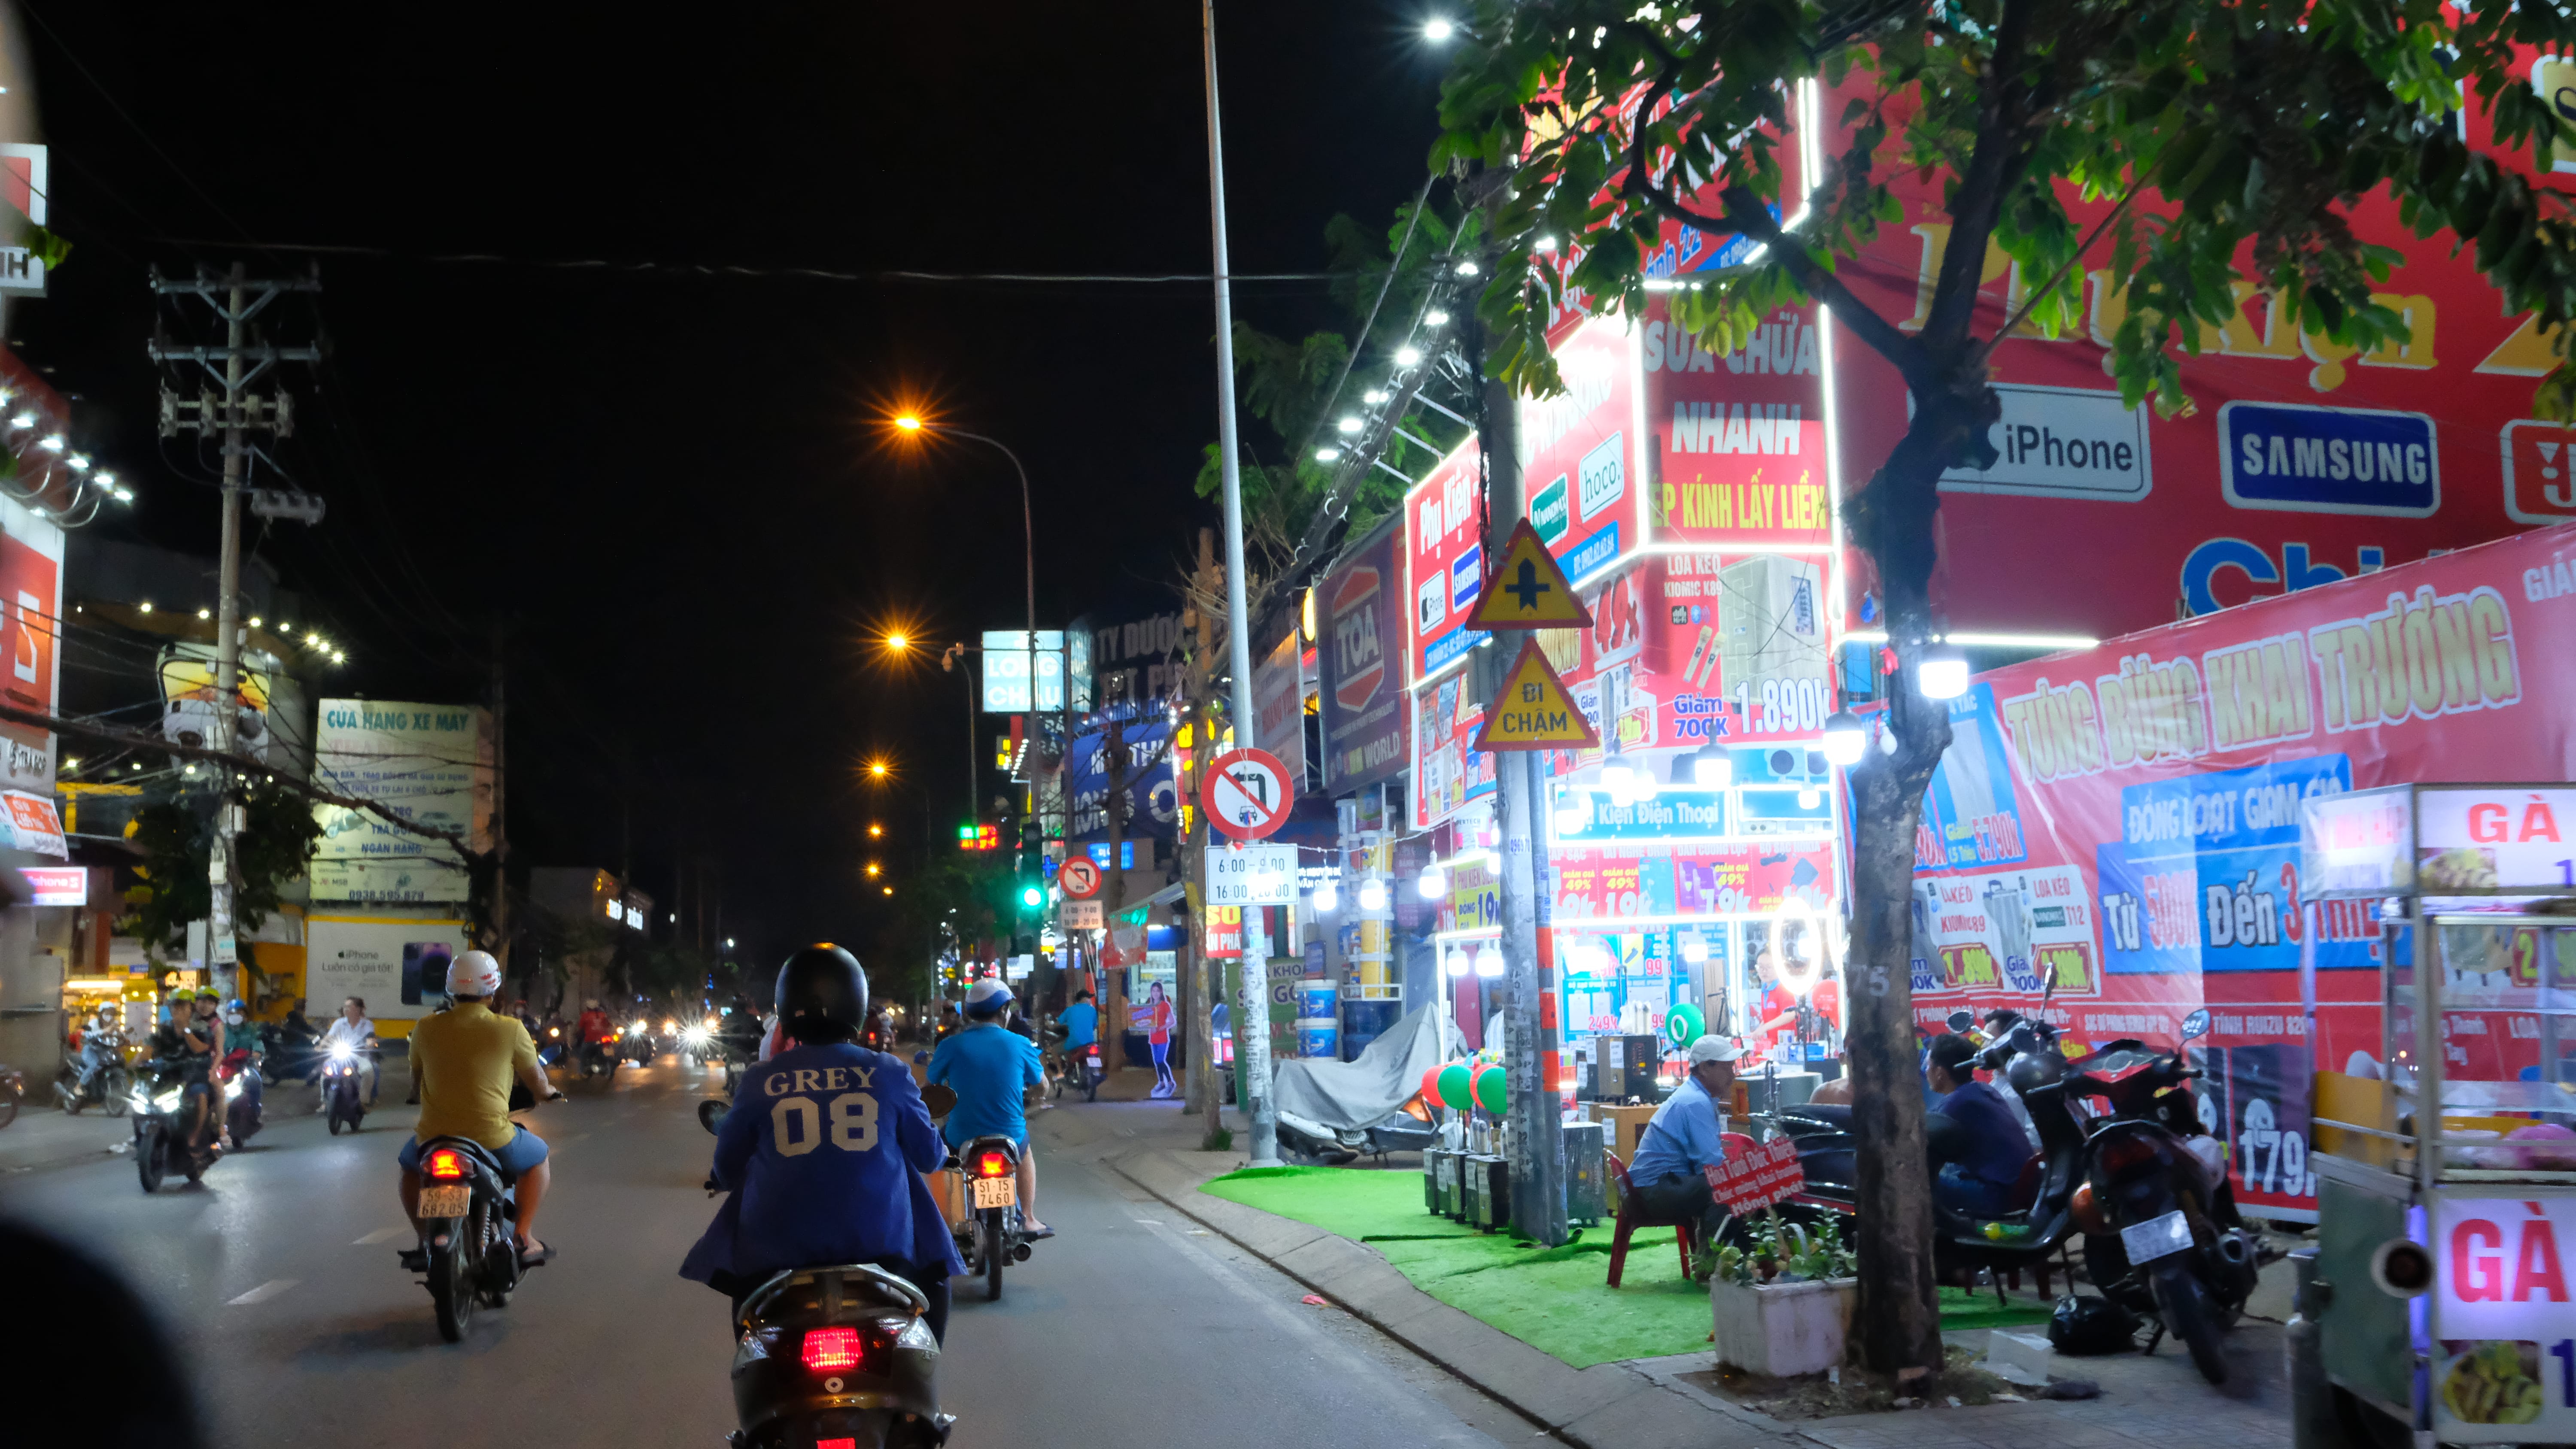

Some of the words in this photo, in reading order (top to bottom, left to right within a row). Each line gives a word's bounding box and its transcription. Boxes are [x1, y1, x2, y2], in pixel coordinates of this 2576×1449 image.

[1671, 400, 1801, 455] NHANH
[2005, 424, 2133, 471] iPhone
[2242, 433, 2427, 485] SAMSUNG
[1682, 473, 1732, 529] KÍNH
[1738, 467, 1774, 529] LẤY
[1780, 469, 1827, 530] LIỀN
[1420, 497, 1442, 559] Phụ
[1454, 558, 1479, 596] SAMSUNG
[1667, 555, 1693, 576] LOA
[1337, 604, 1379, 674] TOA
[1674, 694, 1722, 715] Giảm
[2203, 632, 2314, 752] KHAI
[1503, 707, 1567, 737] CHẬM
[1363, 731, 1402, 770] WORLD
[1637, 800, 1674, 831] Điện
[1676, 801, 1719, 829] Thoại
[2128, 788, 2180, 844] ĐỒNG
[2467, 795, 2563, 843] GÀ
[1219, 858, 1245, 873] 6:00
[1260, 858, 1285, 872] 900
[1565, 879, 1592, 891] 49%
[1607, 877, 1636, 890] 49%
[1717, 873, 1745, 887] 49%
[1216, 885, 1248, 899] 16:00
[2103, 890, 2142, 951] Từ
[2205, 870, 2279, 949] Đến
[764, 1067, 877, 1097] GREY
[771, 1092, 879, 1158] 08
[980, 1192, 1010, 1206] 7460
[2451, 1201, 2570, 1302] GÀ
